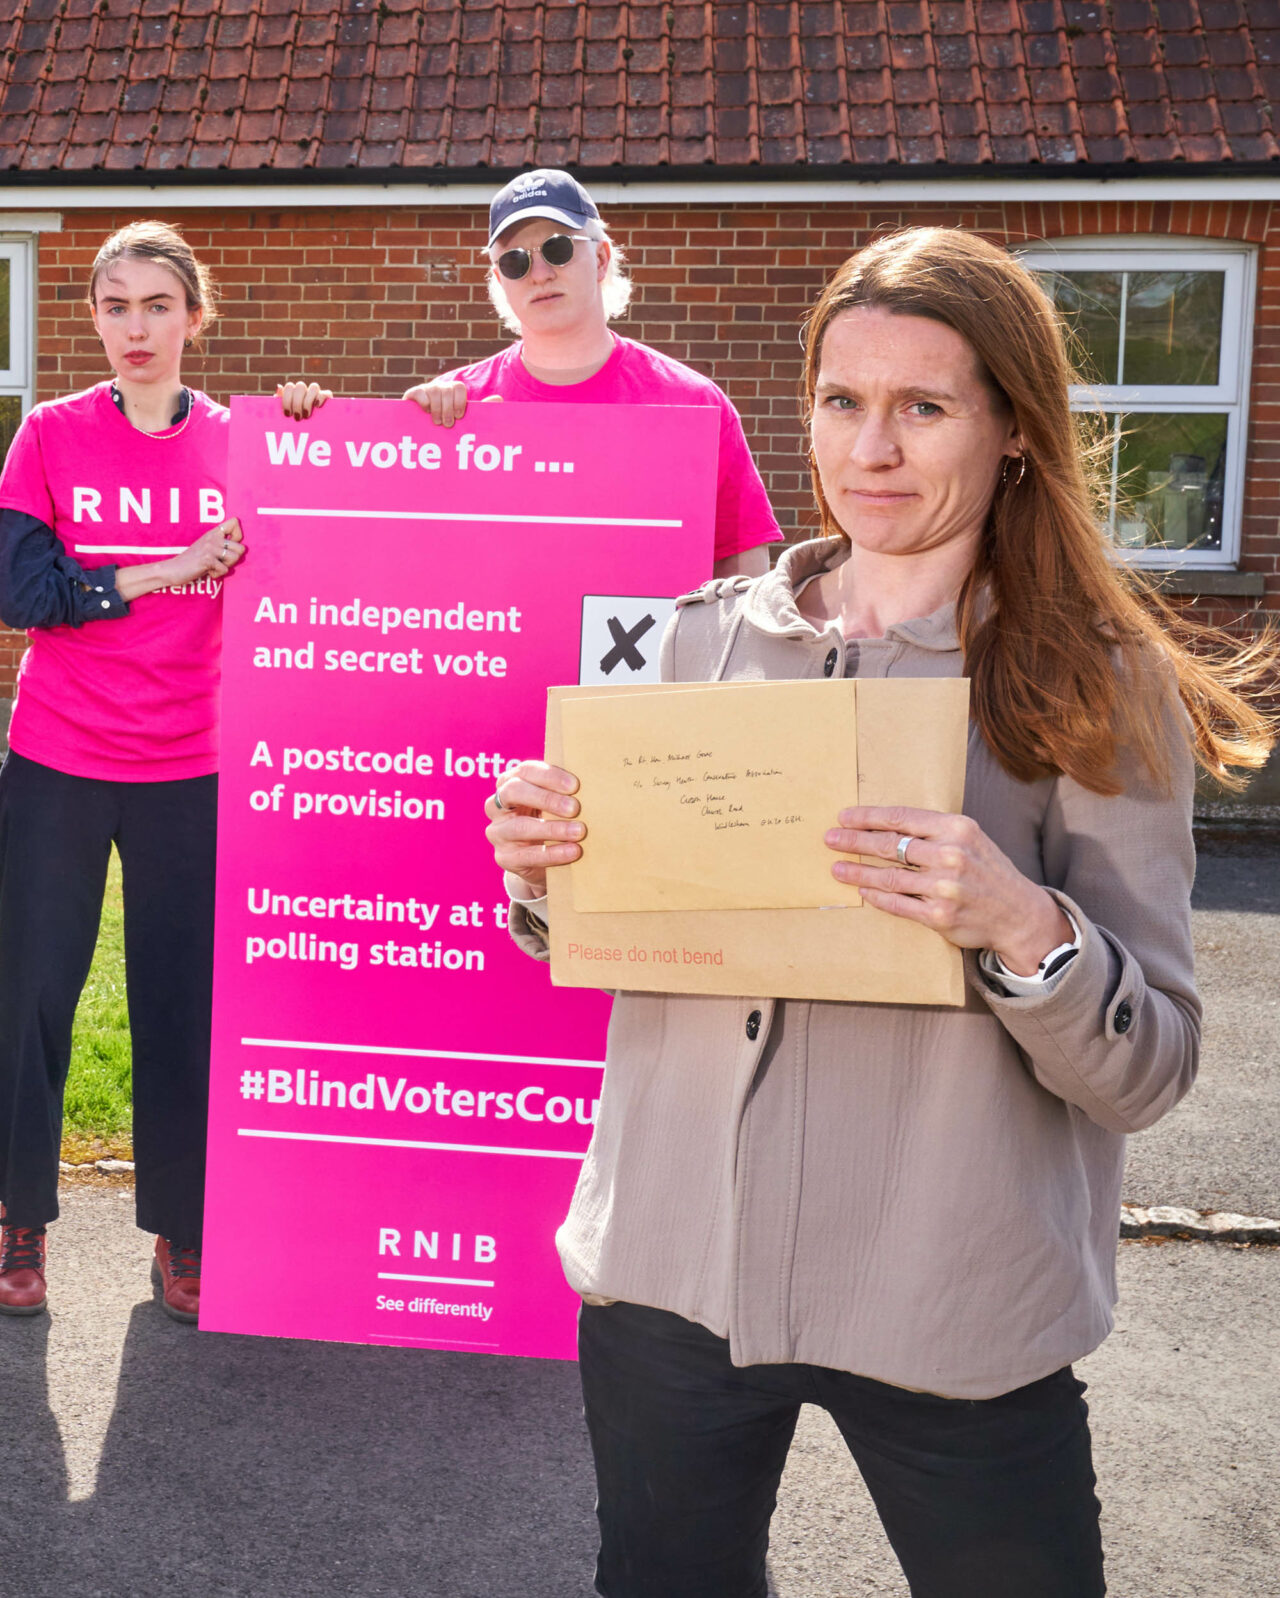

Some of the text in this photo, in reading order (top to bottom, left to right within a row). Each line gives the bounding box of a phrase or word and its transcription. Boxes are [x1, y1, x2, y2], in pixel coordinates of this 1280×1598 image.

[512, 190, 548, 203] adidas
[265, 432, 331, 467] We
[345, 436, 441, 470] vote
[456, 434, 522, 471] for
[73, 487, 225, 524] RNIB
[254, 597, 521, 634] An independent
[253, 642, 507, 677] and secret vote
[250, 741, 273, 767] A
[283, 746, 433, 775] postcode
[250, 784, 444, 820] of provision
[248, 888, 439, 930] Uncertainty
[449, 901, 483, 927] at
[246, 932, 484, 971] polling station
[568, 943, 723, 965] Please do not bend
[379, 1228, 496, 1262] RNIB
[376, 1295, 493, 1321] See differently
